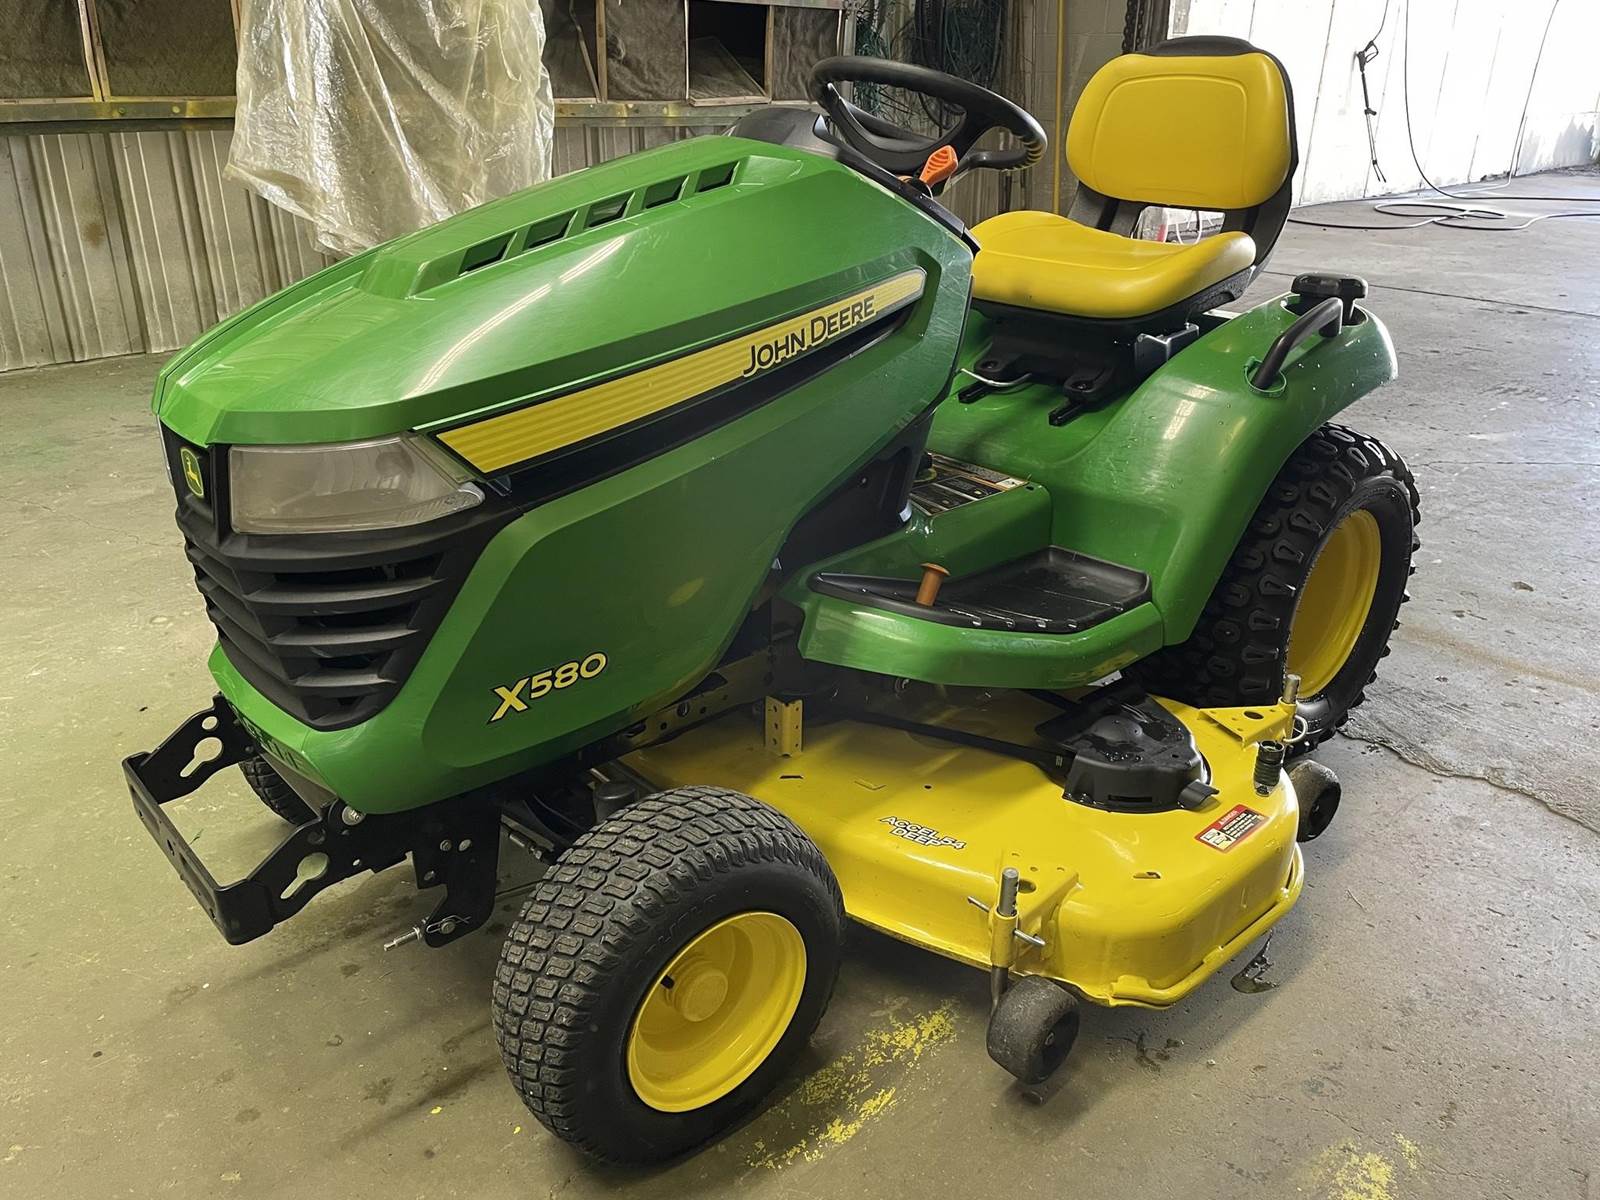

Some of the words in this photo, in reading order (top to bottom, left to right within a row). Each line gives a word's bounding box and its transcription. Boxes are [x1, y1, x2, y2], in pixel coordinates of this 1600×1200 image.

[743, 327, 806, 376] JOHN
[811, 295, 876, 345] DEERE
[487, 651, 608, 724] X580
[879, 816, 940, 840] ACCEL
[889, 827, 942, 847] DEEP
